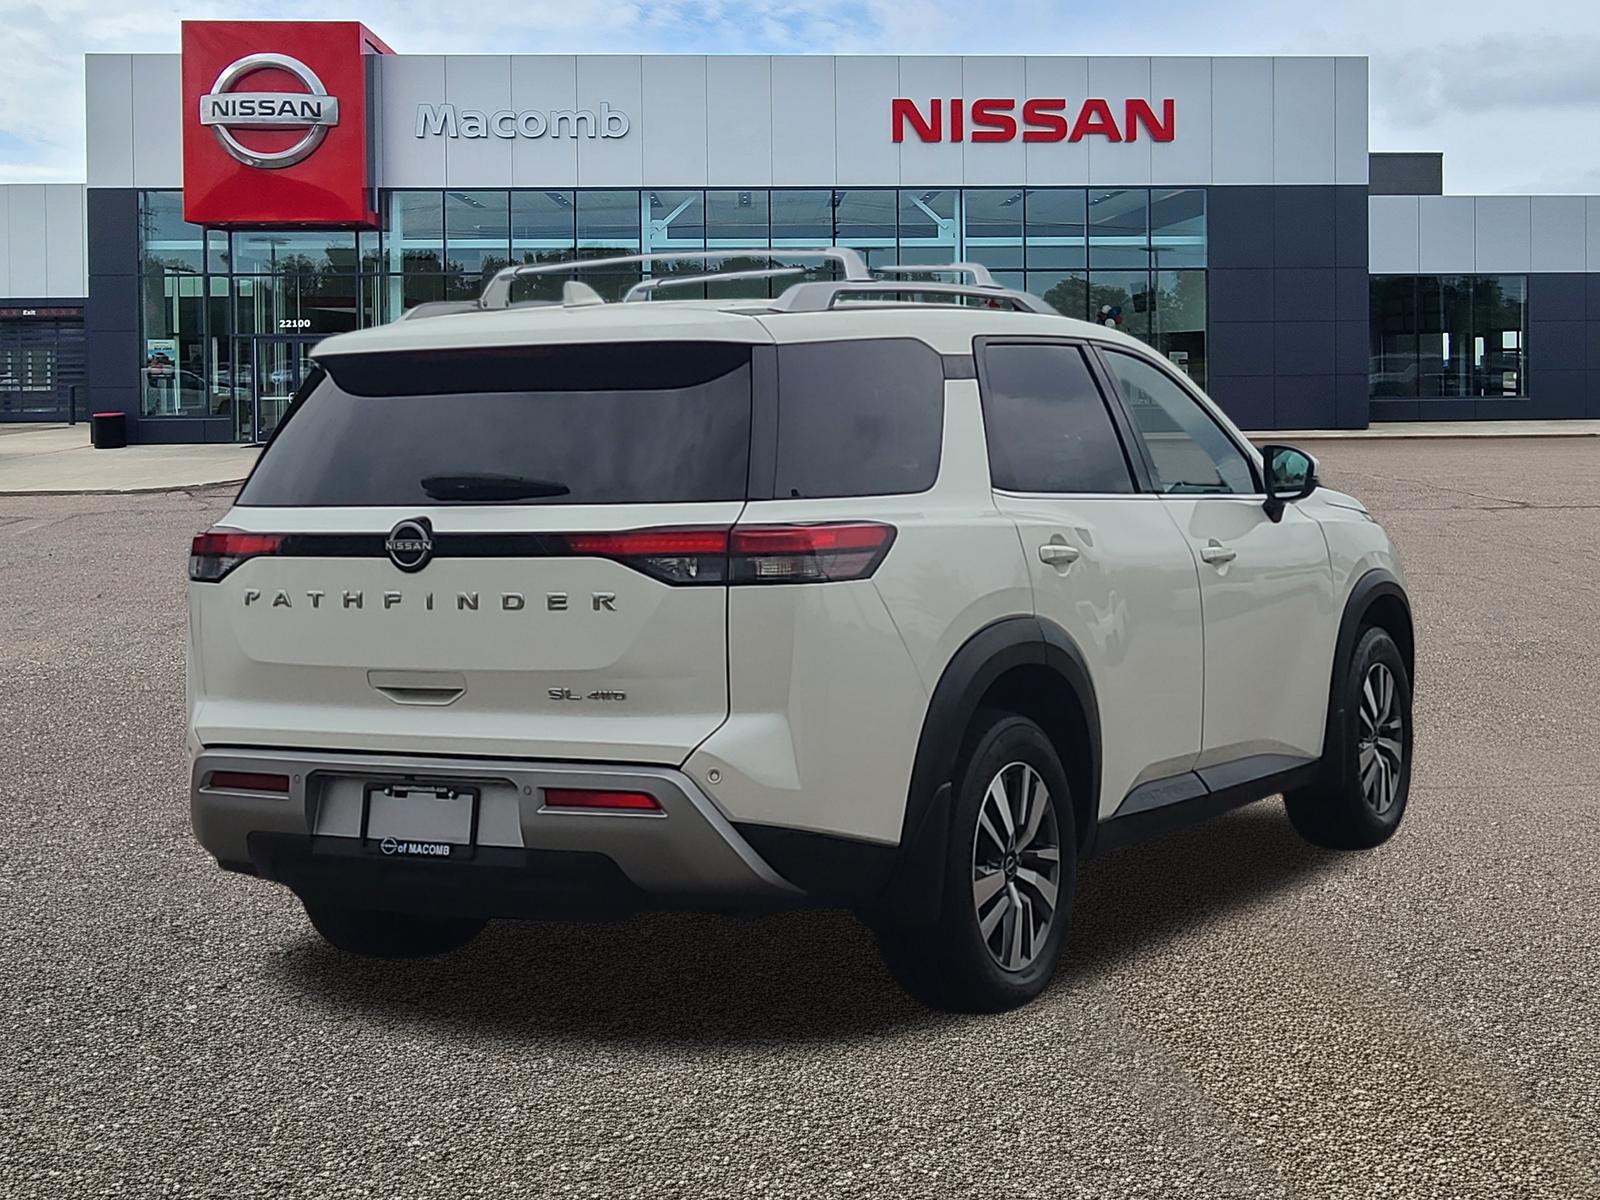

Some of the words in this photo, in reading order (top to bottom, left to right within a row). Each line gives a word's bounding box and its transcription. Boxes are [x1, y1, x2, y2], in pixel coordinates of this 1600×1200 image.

[212, 100, 321, 117] NISSAN
[415, 102, 630, 139] Macomb
[892, 99, 1175, 143] NISSAN
[279, 319, 311, 328] 22100
[385, 541, 432, 550] NISSAN
[244, 588, 618, 611] PATHFINDER
[547, 687, 582, 700] SL
[587, 690, 626, 701] 4WD
[397, 843, 408, 853] of
[408, 843, 450, 856] MACOMB
